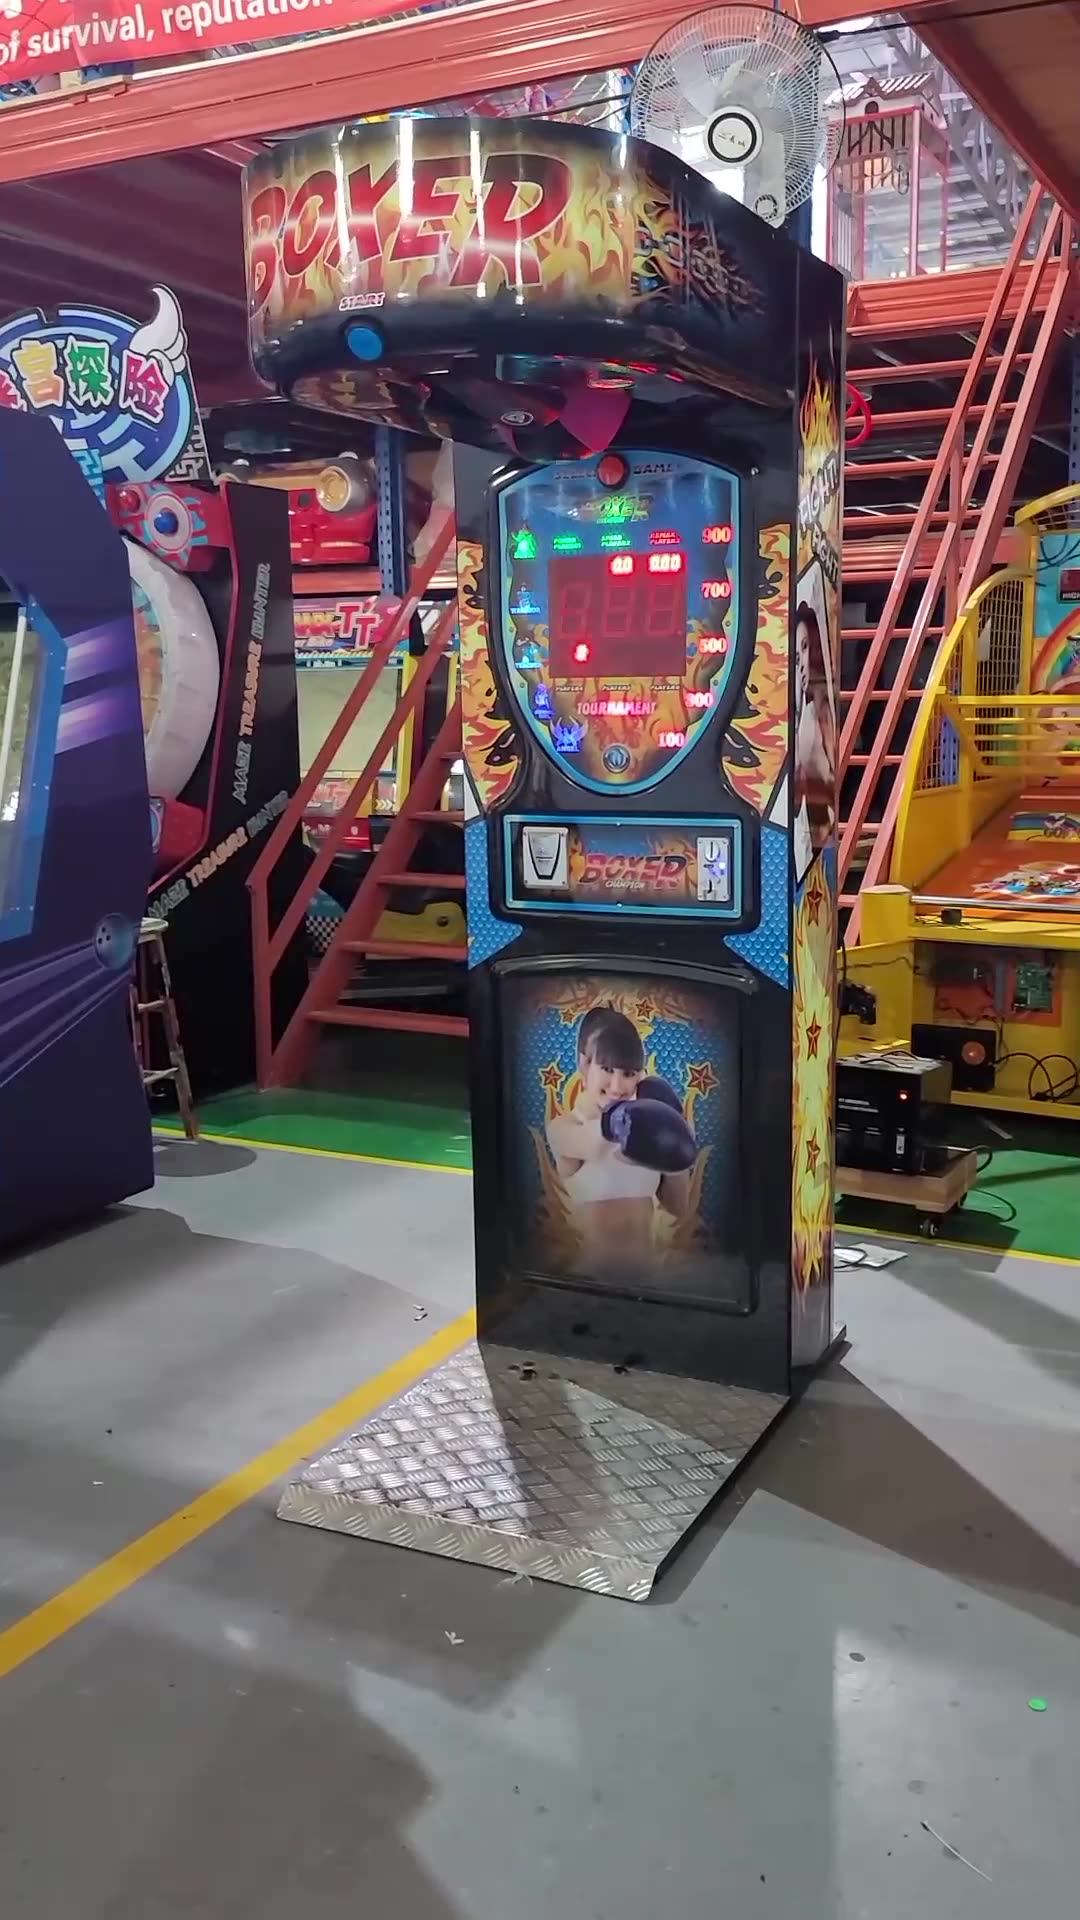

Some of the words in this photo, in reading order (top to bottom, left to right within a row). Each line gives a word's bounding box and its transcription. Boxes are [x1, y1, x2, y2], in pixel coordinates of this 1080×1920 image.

[0, 29, 20, 66] of
[27, 3, 155, 57] survival,
[162, 0, 334, 41] reputatio
[249, 153, 574, 318] BOXER
[338, 292, 385, 311] START
[702, 526, 732, 544] 900
[702, 581, 731, 599] 700
[699, 637, 728, 654] 500
[658, 732, 686, 748] 100
[578, 853, 688, 889] BOXER
